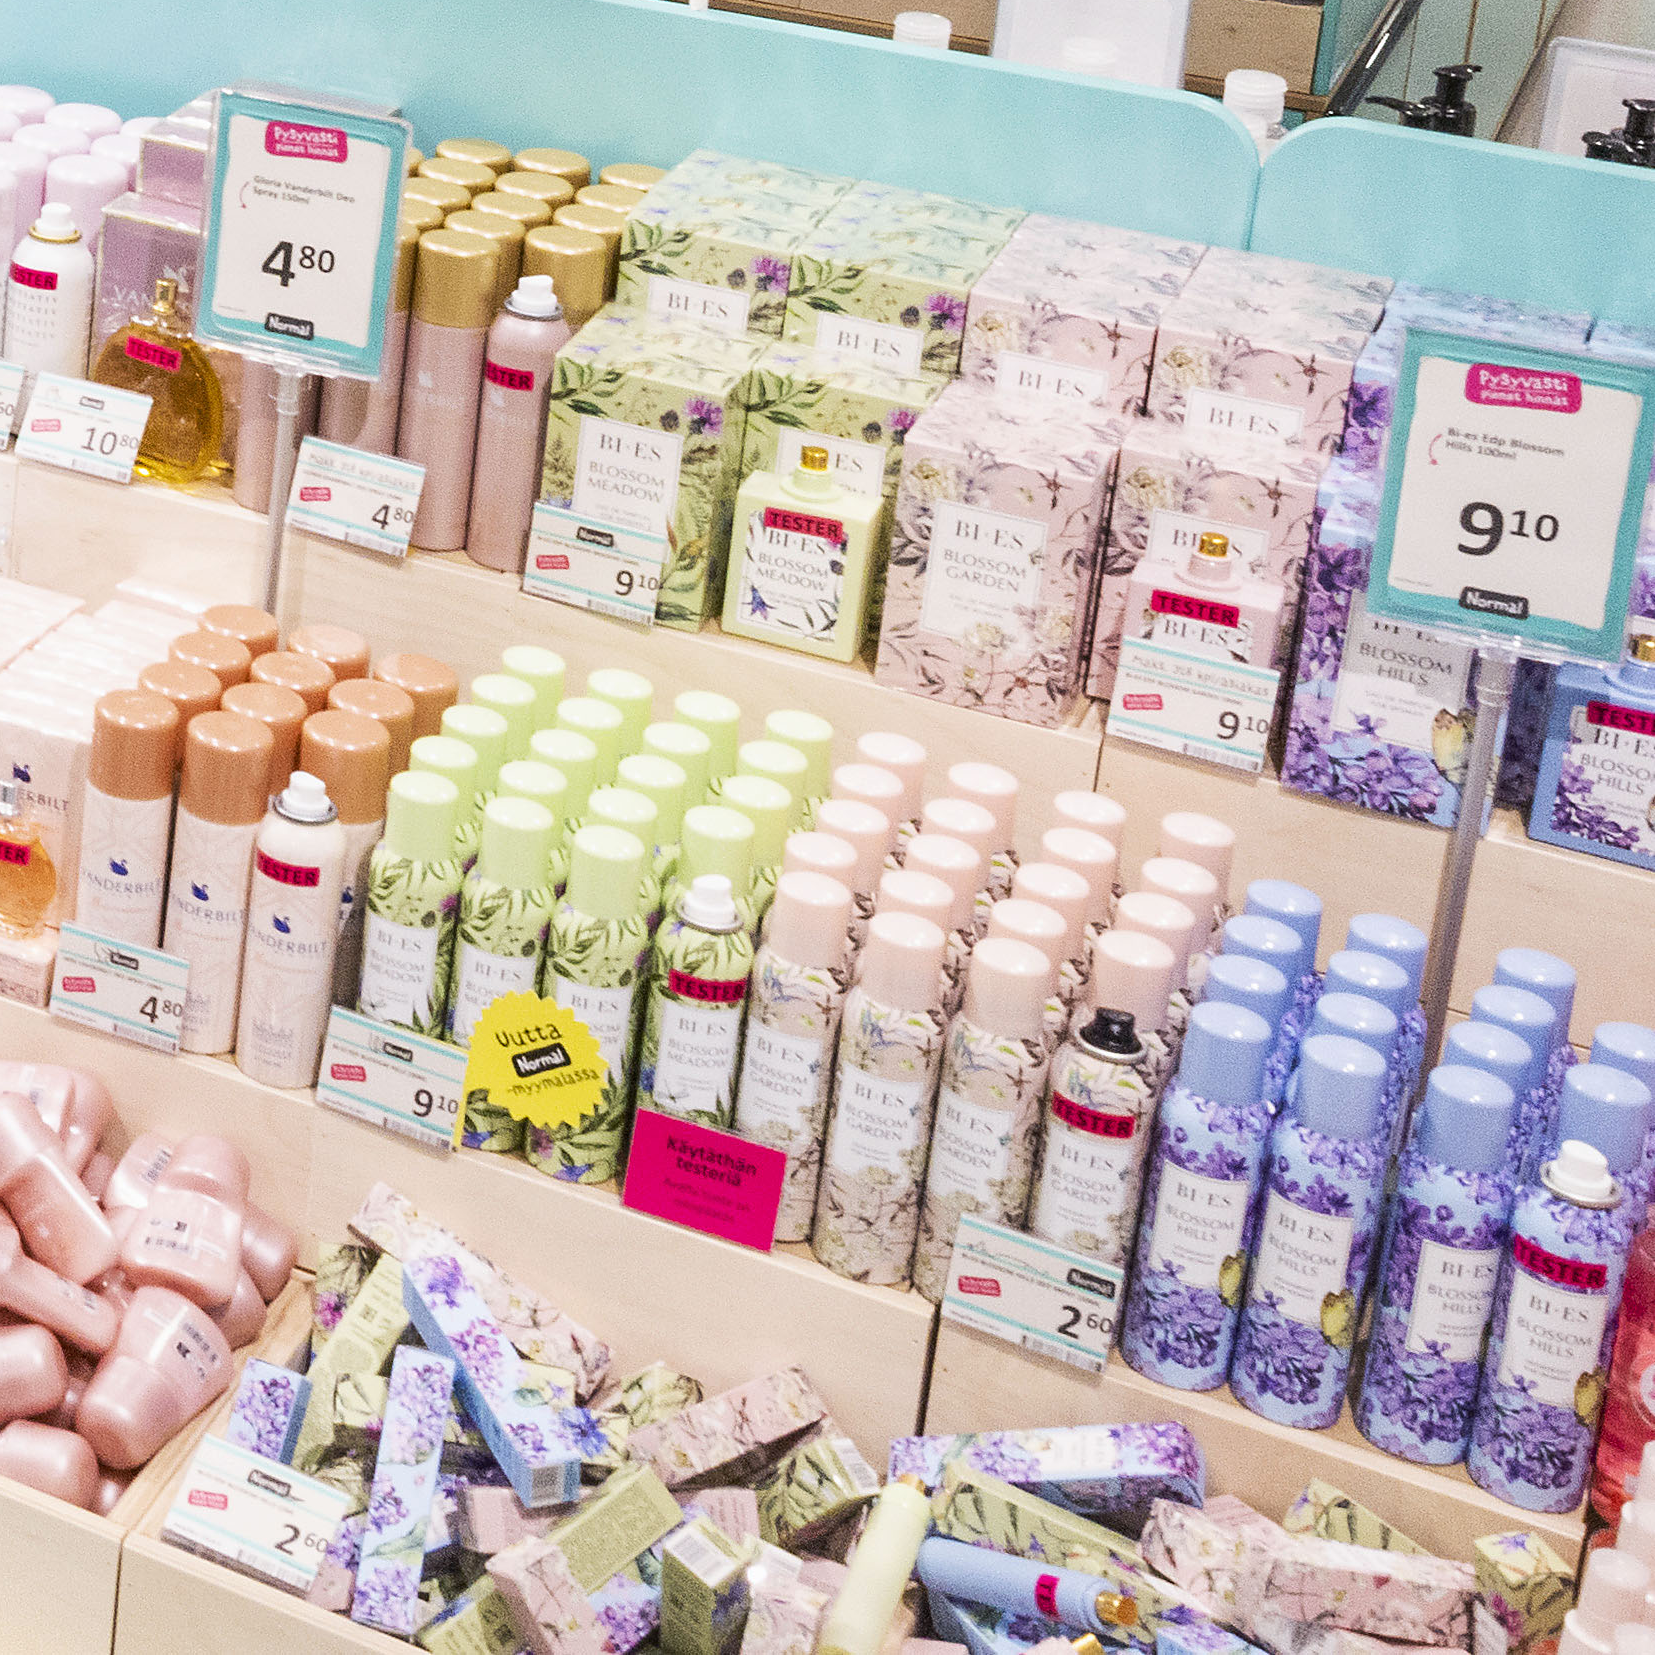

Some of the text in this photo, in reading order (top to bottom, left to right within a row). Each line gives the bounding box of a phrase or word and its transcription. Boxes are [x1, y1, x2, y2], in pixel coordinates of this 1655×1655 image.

[268, 316, 311, 338] Normal
[129, 338, 177, 368] TESTER
[488, 366, 533, 389] STER
[589, 461, 666, 489] BLOSSOM
[587, 476, 663, 504] MEADOW
[769, 511, 840, 541] TESTER
[757, 552, 830, 581] BLOSSOM
[943, 547, 1028, 581] BLOSSOM
[755, 566, 828, 594] MEADOW
[945, 565, 1021, 595] GARDEN
[1157, 595, 1236, 625] TESTER
[1466, 591, 1524, 615] Normal
[1358, 643, 1453, 675] BLOSSOM
[1377, 665, 1430, 686] HILLS
[1597, 703, 1655, 732] TEST
[1596, 773, 1645, 796] HILLS
[671, 977, 744, 1000] TESTER
[496, 1024, 561, 1049] Uutta
[518, 1049, 565, 1073] Normal
[1055, 1100, 1132, 1138] TESTER
[1165, 1204, 1236, 1236] BLOSSOM
[1267, 1237, 1337, 1269] BLOSSOM
[1517, 1239, 1605, 1289] TESTER
[1516, 1317, 1594, 1348] BLOSSOM
